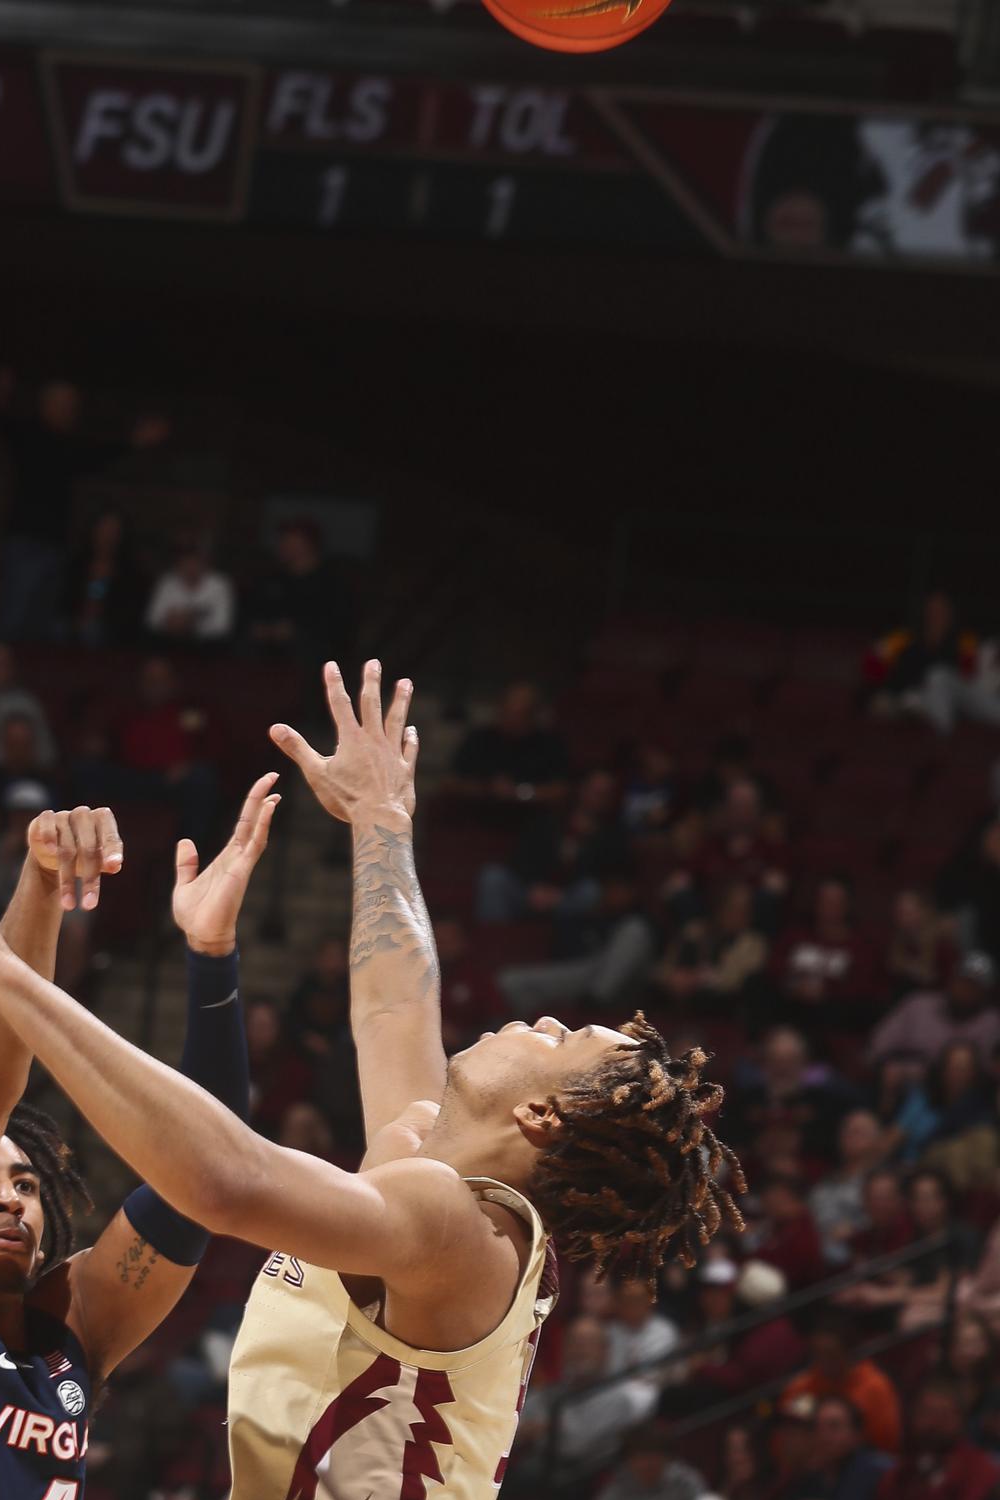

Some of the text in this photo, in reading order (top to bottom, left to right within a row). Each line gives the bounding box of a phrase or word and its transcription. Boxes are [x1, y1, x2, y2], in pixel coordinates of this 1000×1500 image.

[74, 90, 235, 172] FSU
[266, 72, 391, 142] FLS
[468, 85, 580, 154] TOL
[317, 164, 348, 228] 1
[486, 176, 517, 238] 1
